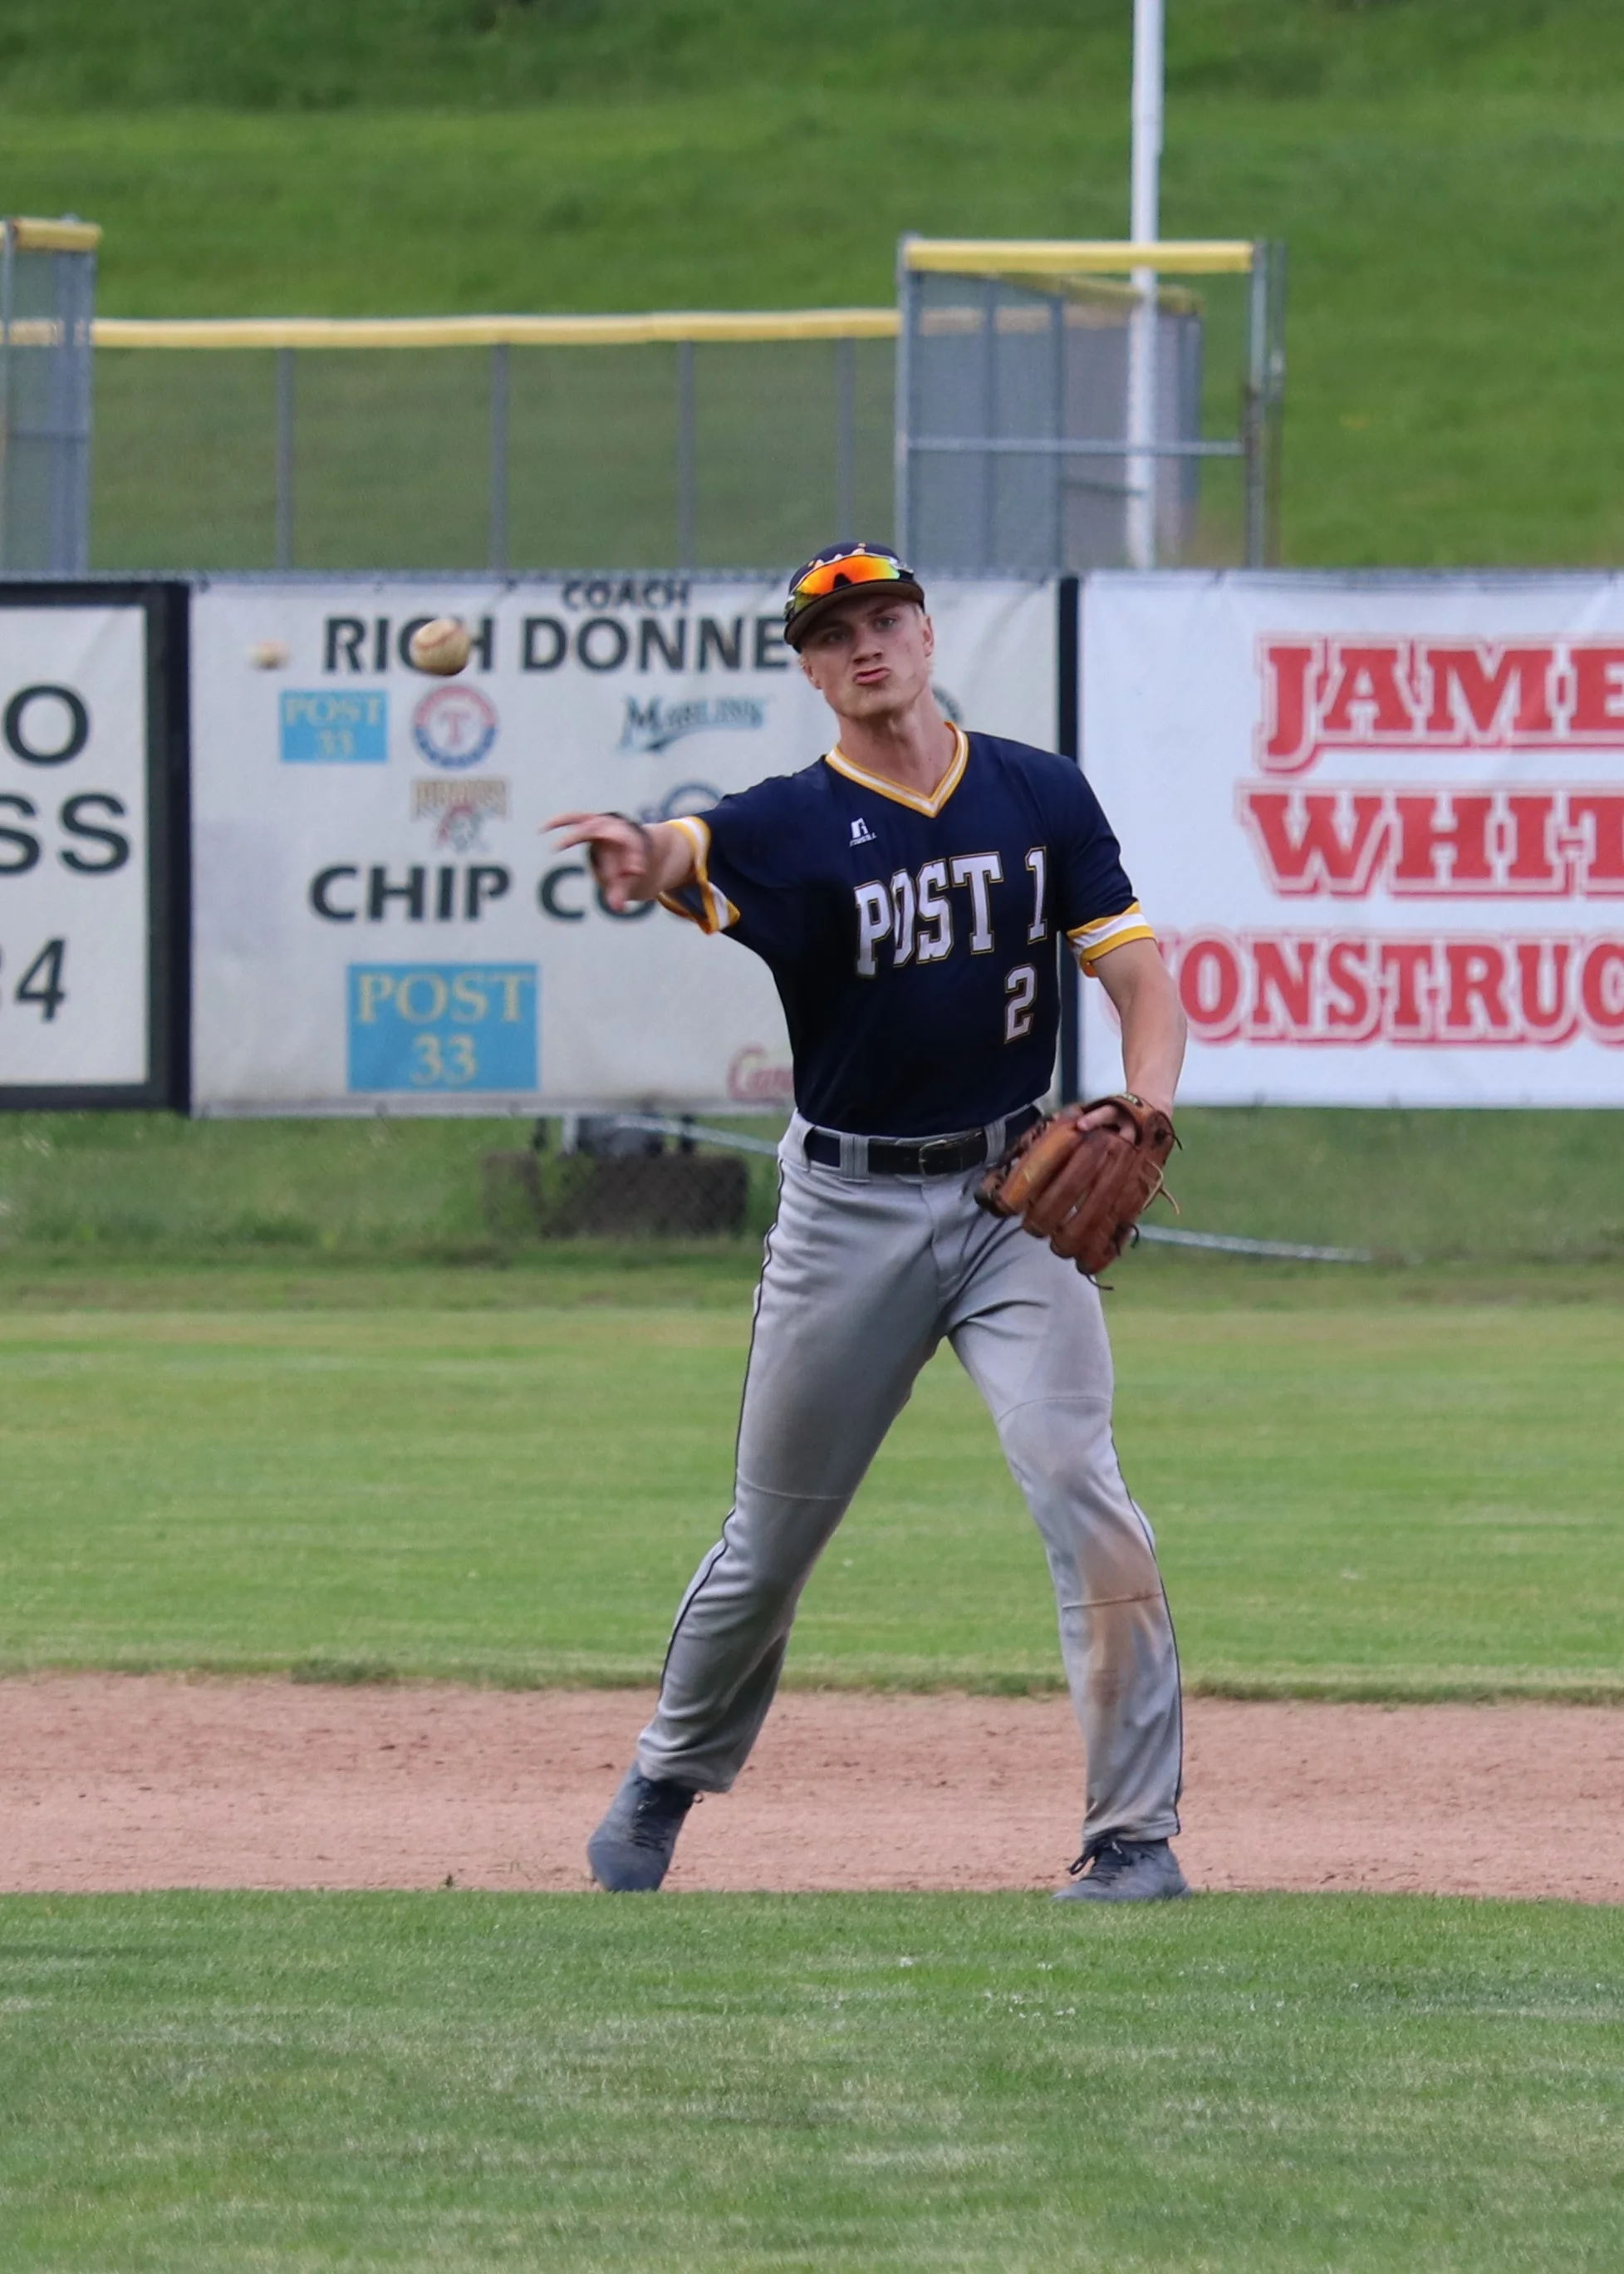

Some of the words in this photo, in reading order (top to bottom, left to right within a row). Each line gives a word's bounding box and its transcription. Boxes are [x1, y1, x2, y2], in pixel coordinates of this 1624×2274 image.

[562, 579, 689, 611] COACH
[325, 616, 493, 671] RICH
[286, 696, 381, 726] POST
[308, 865, 511, 921] CHIP
[854, 850, 1003, 979] POST
[1024, 845, 1047, 945] 1
[0, 937, 66, 1022] 4
[355, 973, 532, 1024] POST
[1003, 963, 1037, 1044] 2
[1101, 926, 1624, 1049] ONSTRUC
[410, 1034, 477, 1085] 33
